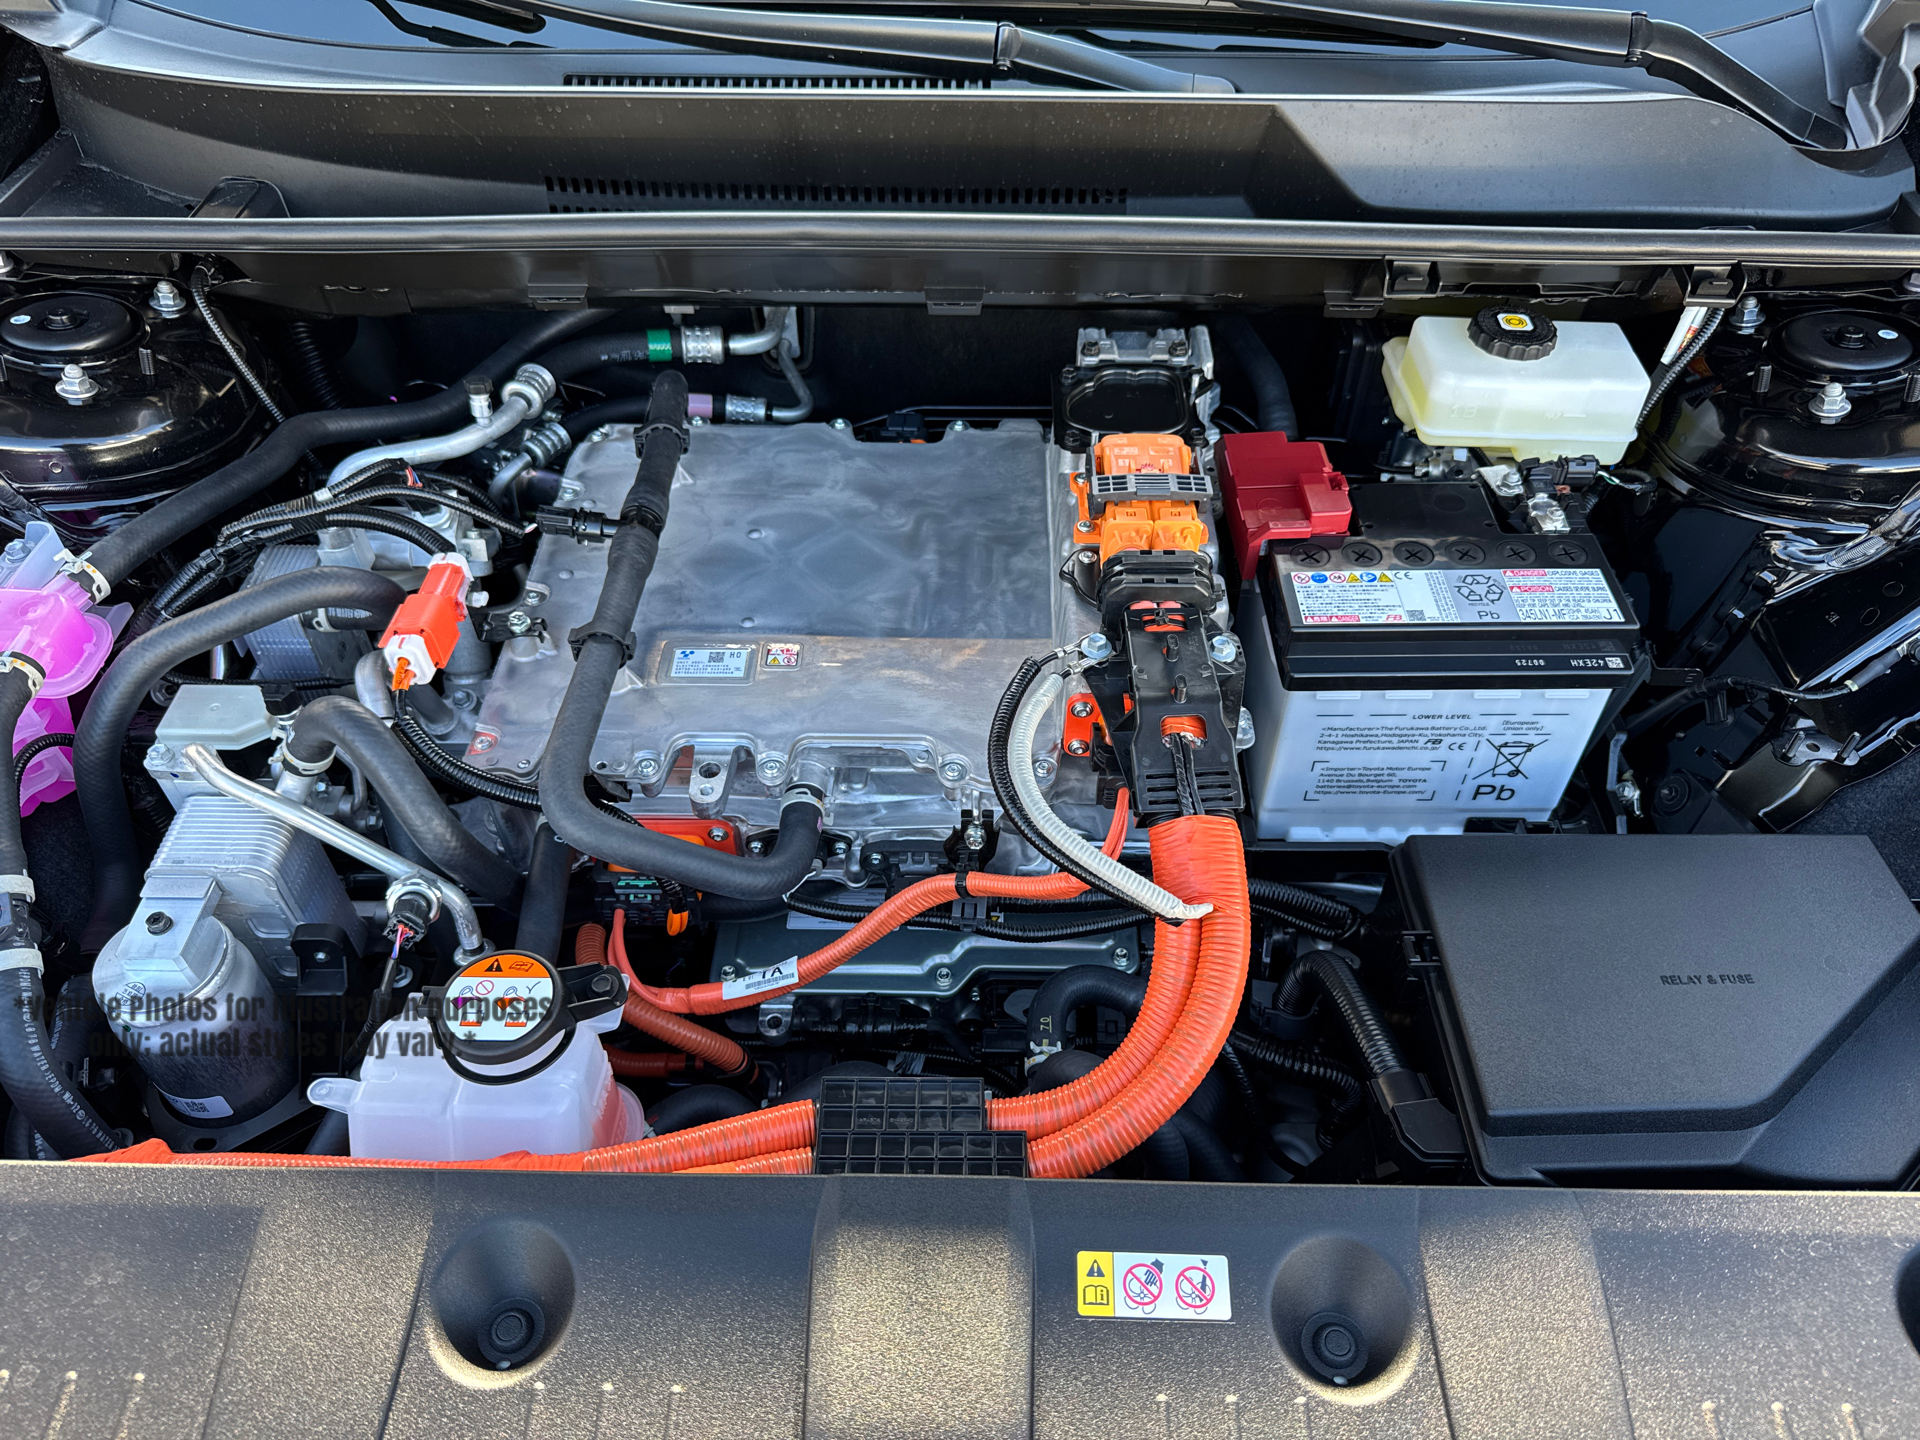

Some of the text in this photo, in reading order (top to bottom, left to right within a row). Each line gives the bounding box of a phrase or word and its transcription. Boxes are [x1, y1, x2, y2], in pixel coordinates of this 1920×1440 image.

[1477, 610, 1500, 620] Pb
[1519, 608, 1567, 620] 345LN1-MF
[1570, 659, 1604, 667] 42EXH
[1471, 784, 1516, 801] Pb
[1660, 973, 1755, 985] RELAY & FUSE
